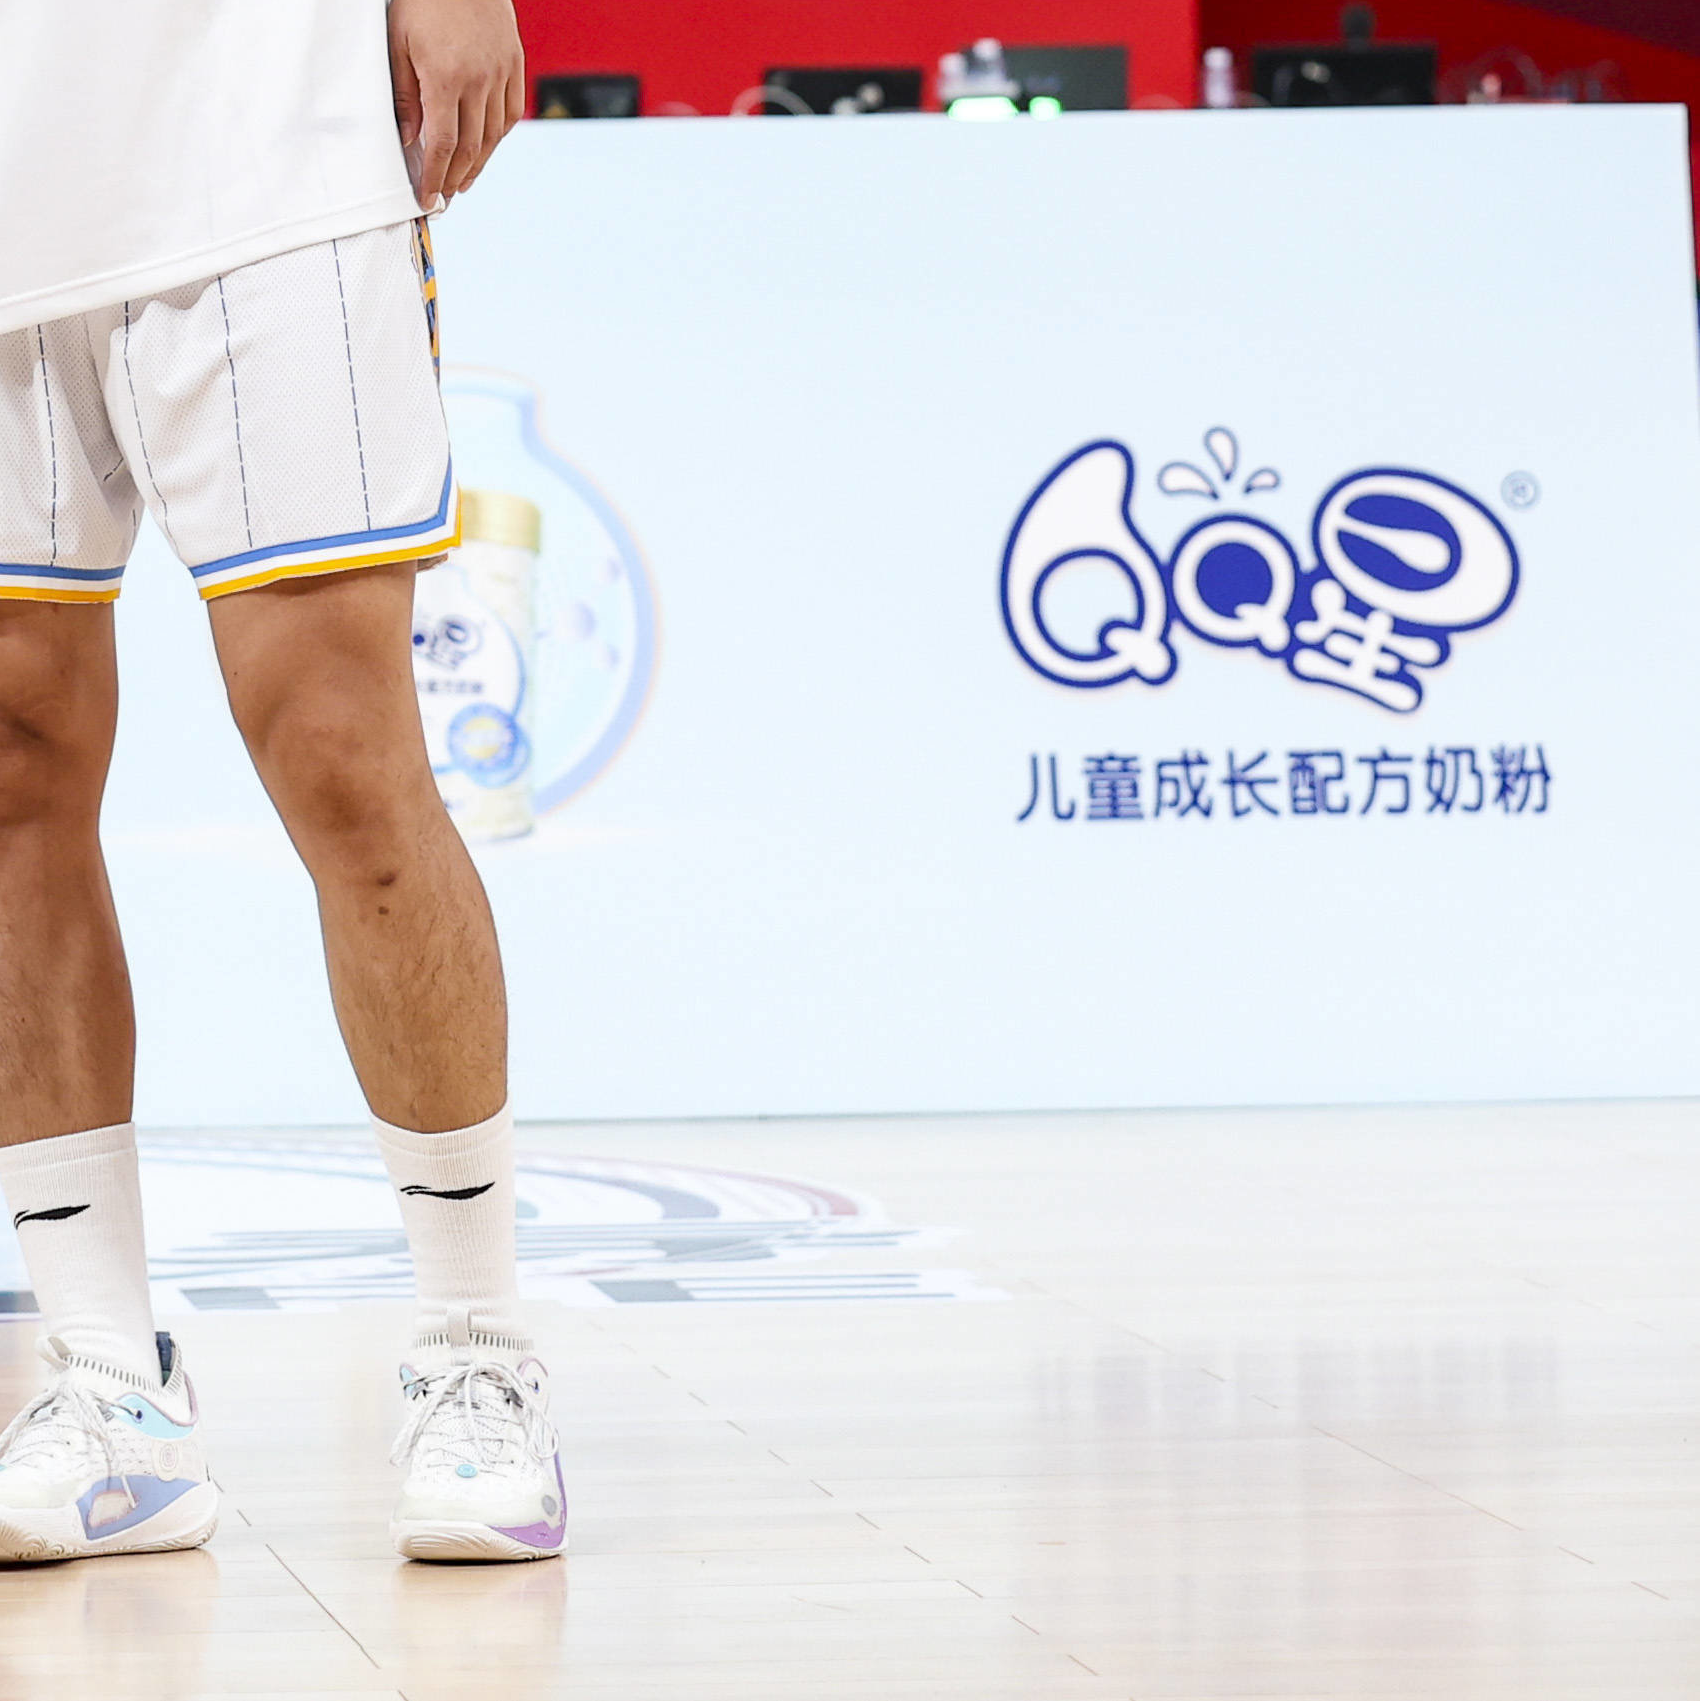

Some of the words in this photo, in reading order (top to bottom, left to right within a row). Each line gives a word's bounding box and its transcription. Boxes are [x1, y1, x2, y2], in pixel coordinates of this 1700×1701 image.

[1000, 437, 1520, 715] QQ星
[1016, 741, 1554, 823] 儿童成长配方奶粉
